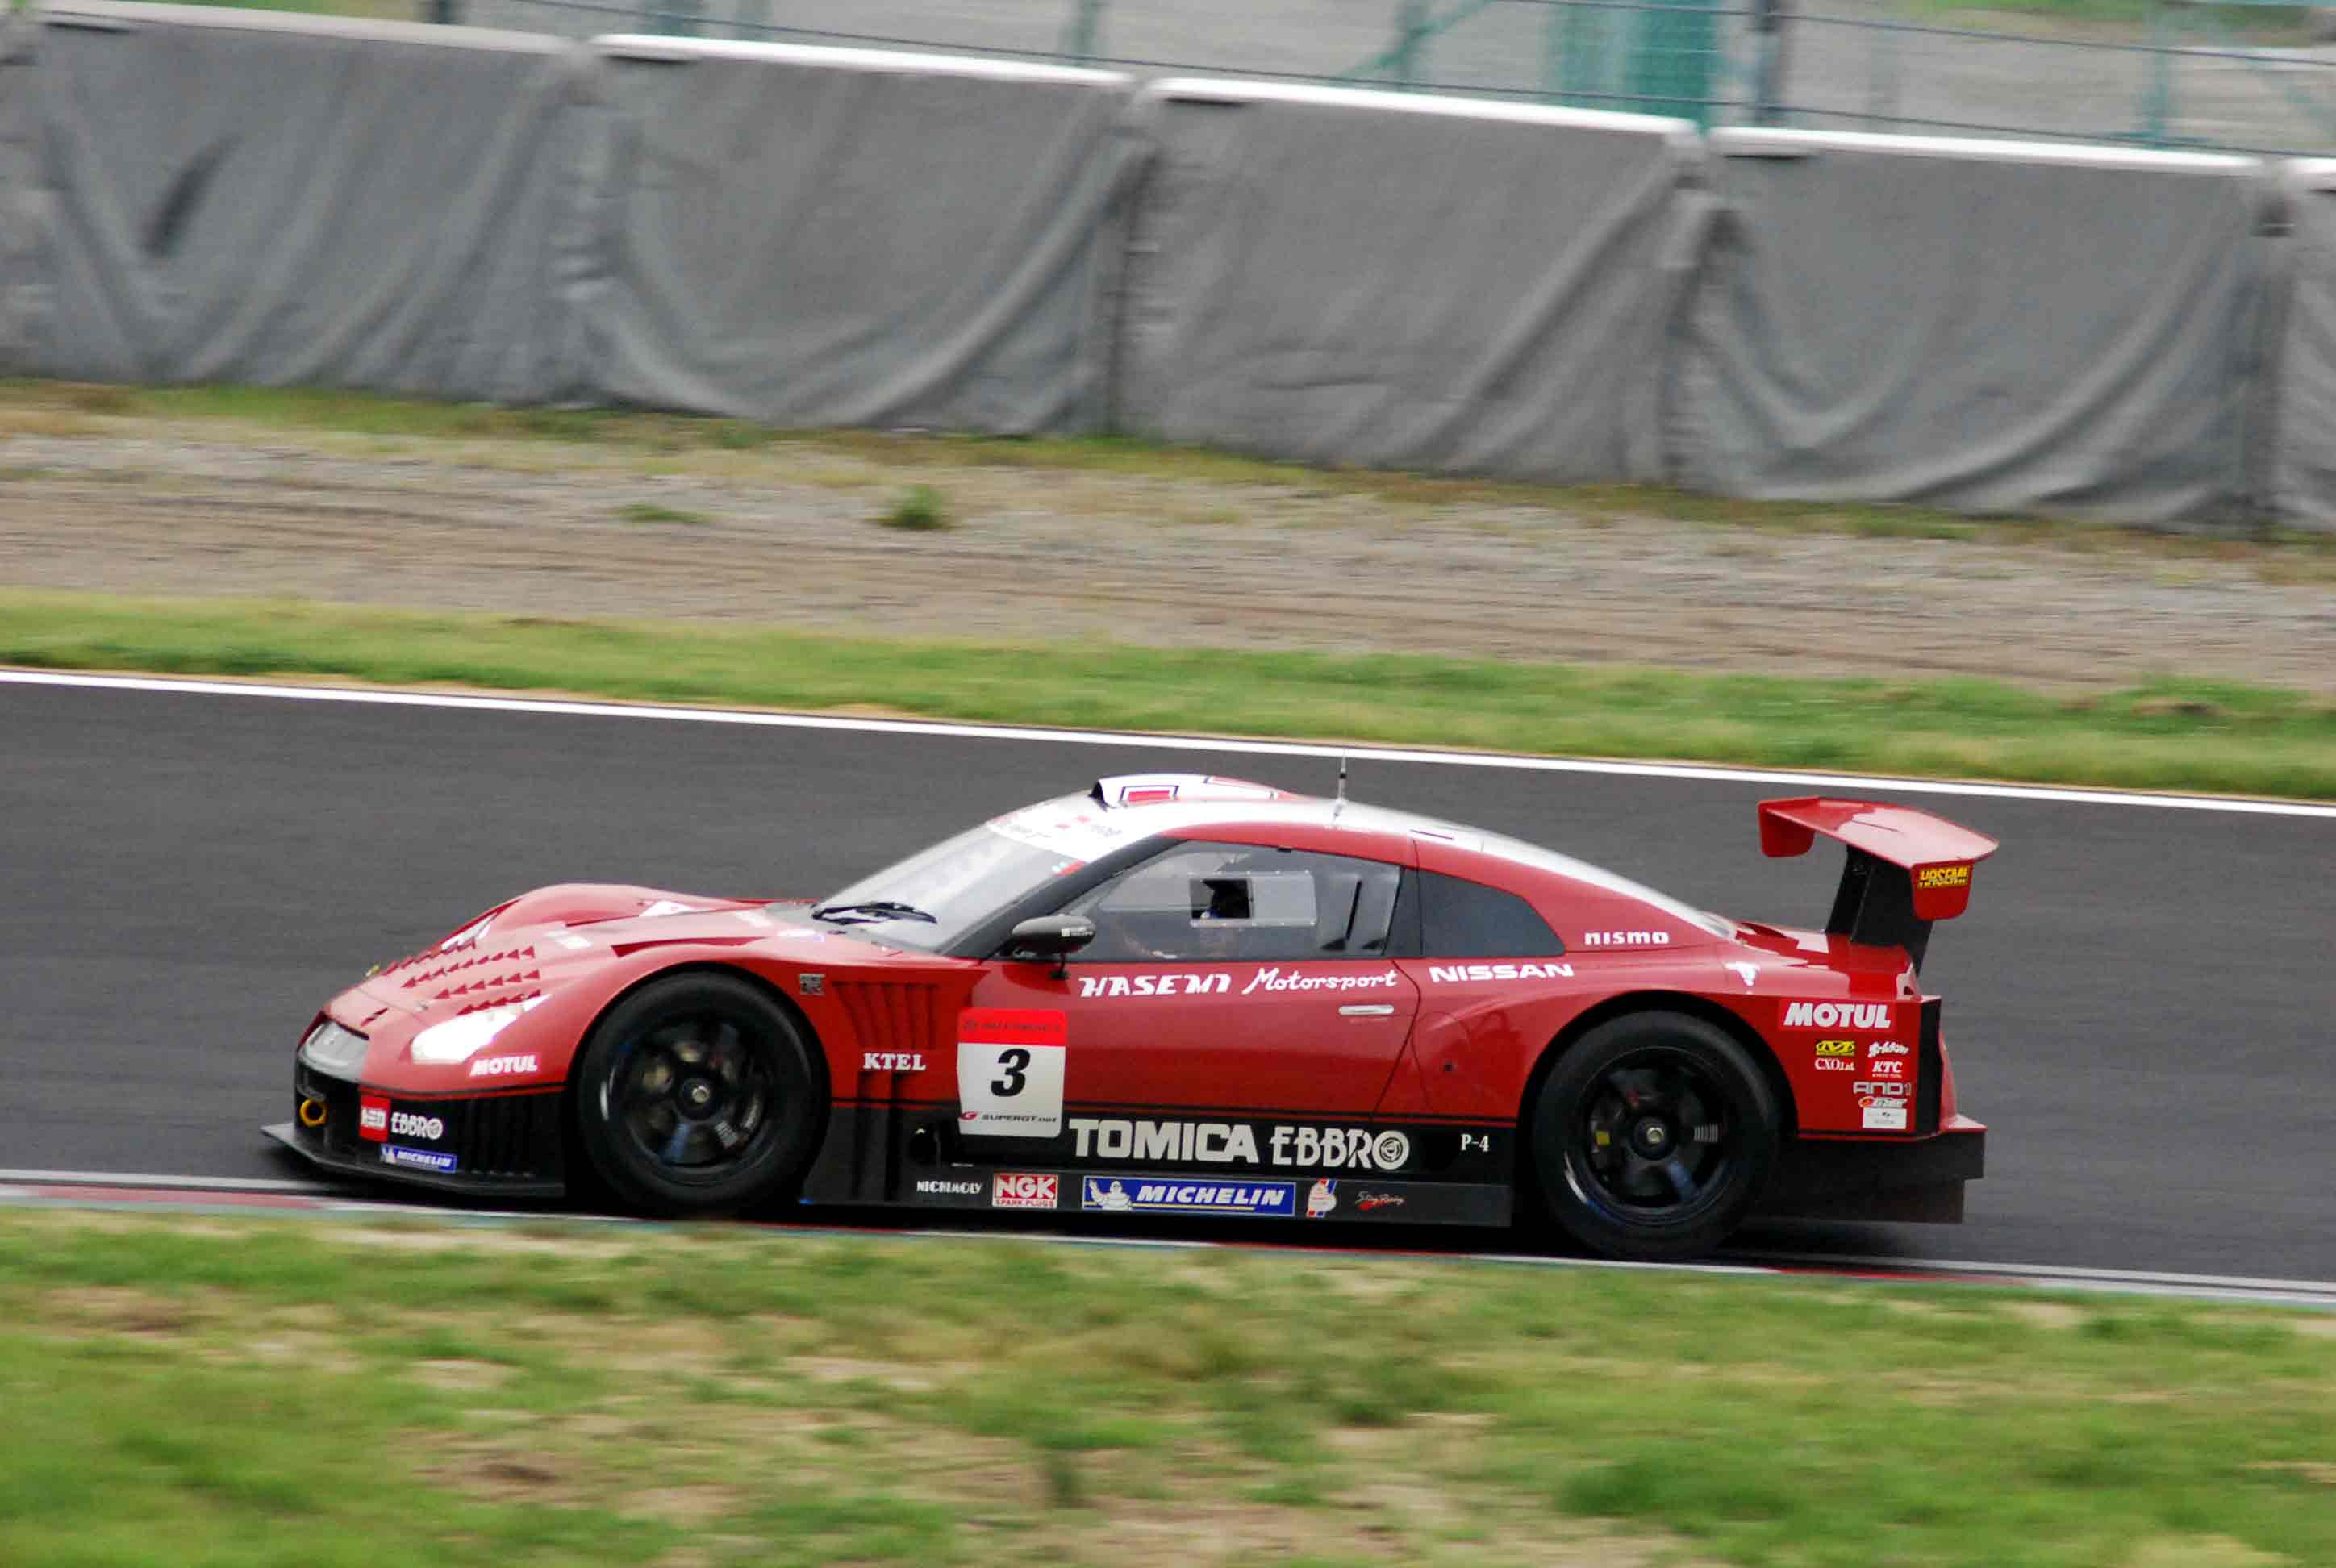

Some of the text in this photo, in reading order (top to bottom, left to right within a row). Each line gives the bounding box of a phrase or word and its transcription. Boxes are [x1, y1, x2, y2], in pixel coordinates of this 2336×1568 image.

[1583, 932, 1669, 945] nismo
[1078, 967, 1398, 998] HASEMI Motorsport
[1429, 964, 1575, 983] NISSAN
[1783, 1002, 1892, 1029] MOTUL
[469, 1055, 538, 1077] MOTUL
[862, 1052, 927, 1071] KTEL
[1871, 1061, 1903, 1074] KTC
[991, 1049, 1031, 1098] 3
[391, 1112, 443, 1140] EBBRO
[1069, 1119, 1410, 1170] TOMICA EBBRO
[1461, 1133, 1490, 1152] P-4
[397, 1151, 452, 1167] MICHELIN
[995, 1175, 1055, 1199] NGK
[1136, 1185, 1286, 1206] MICHELIN
